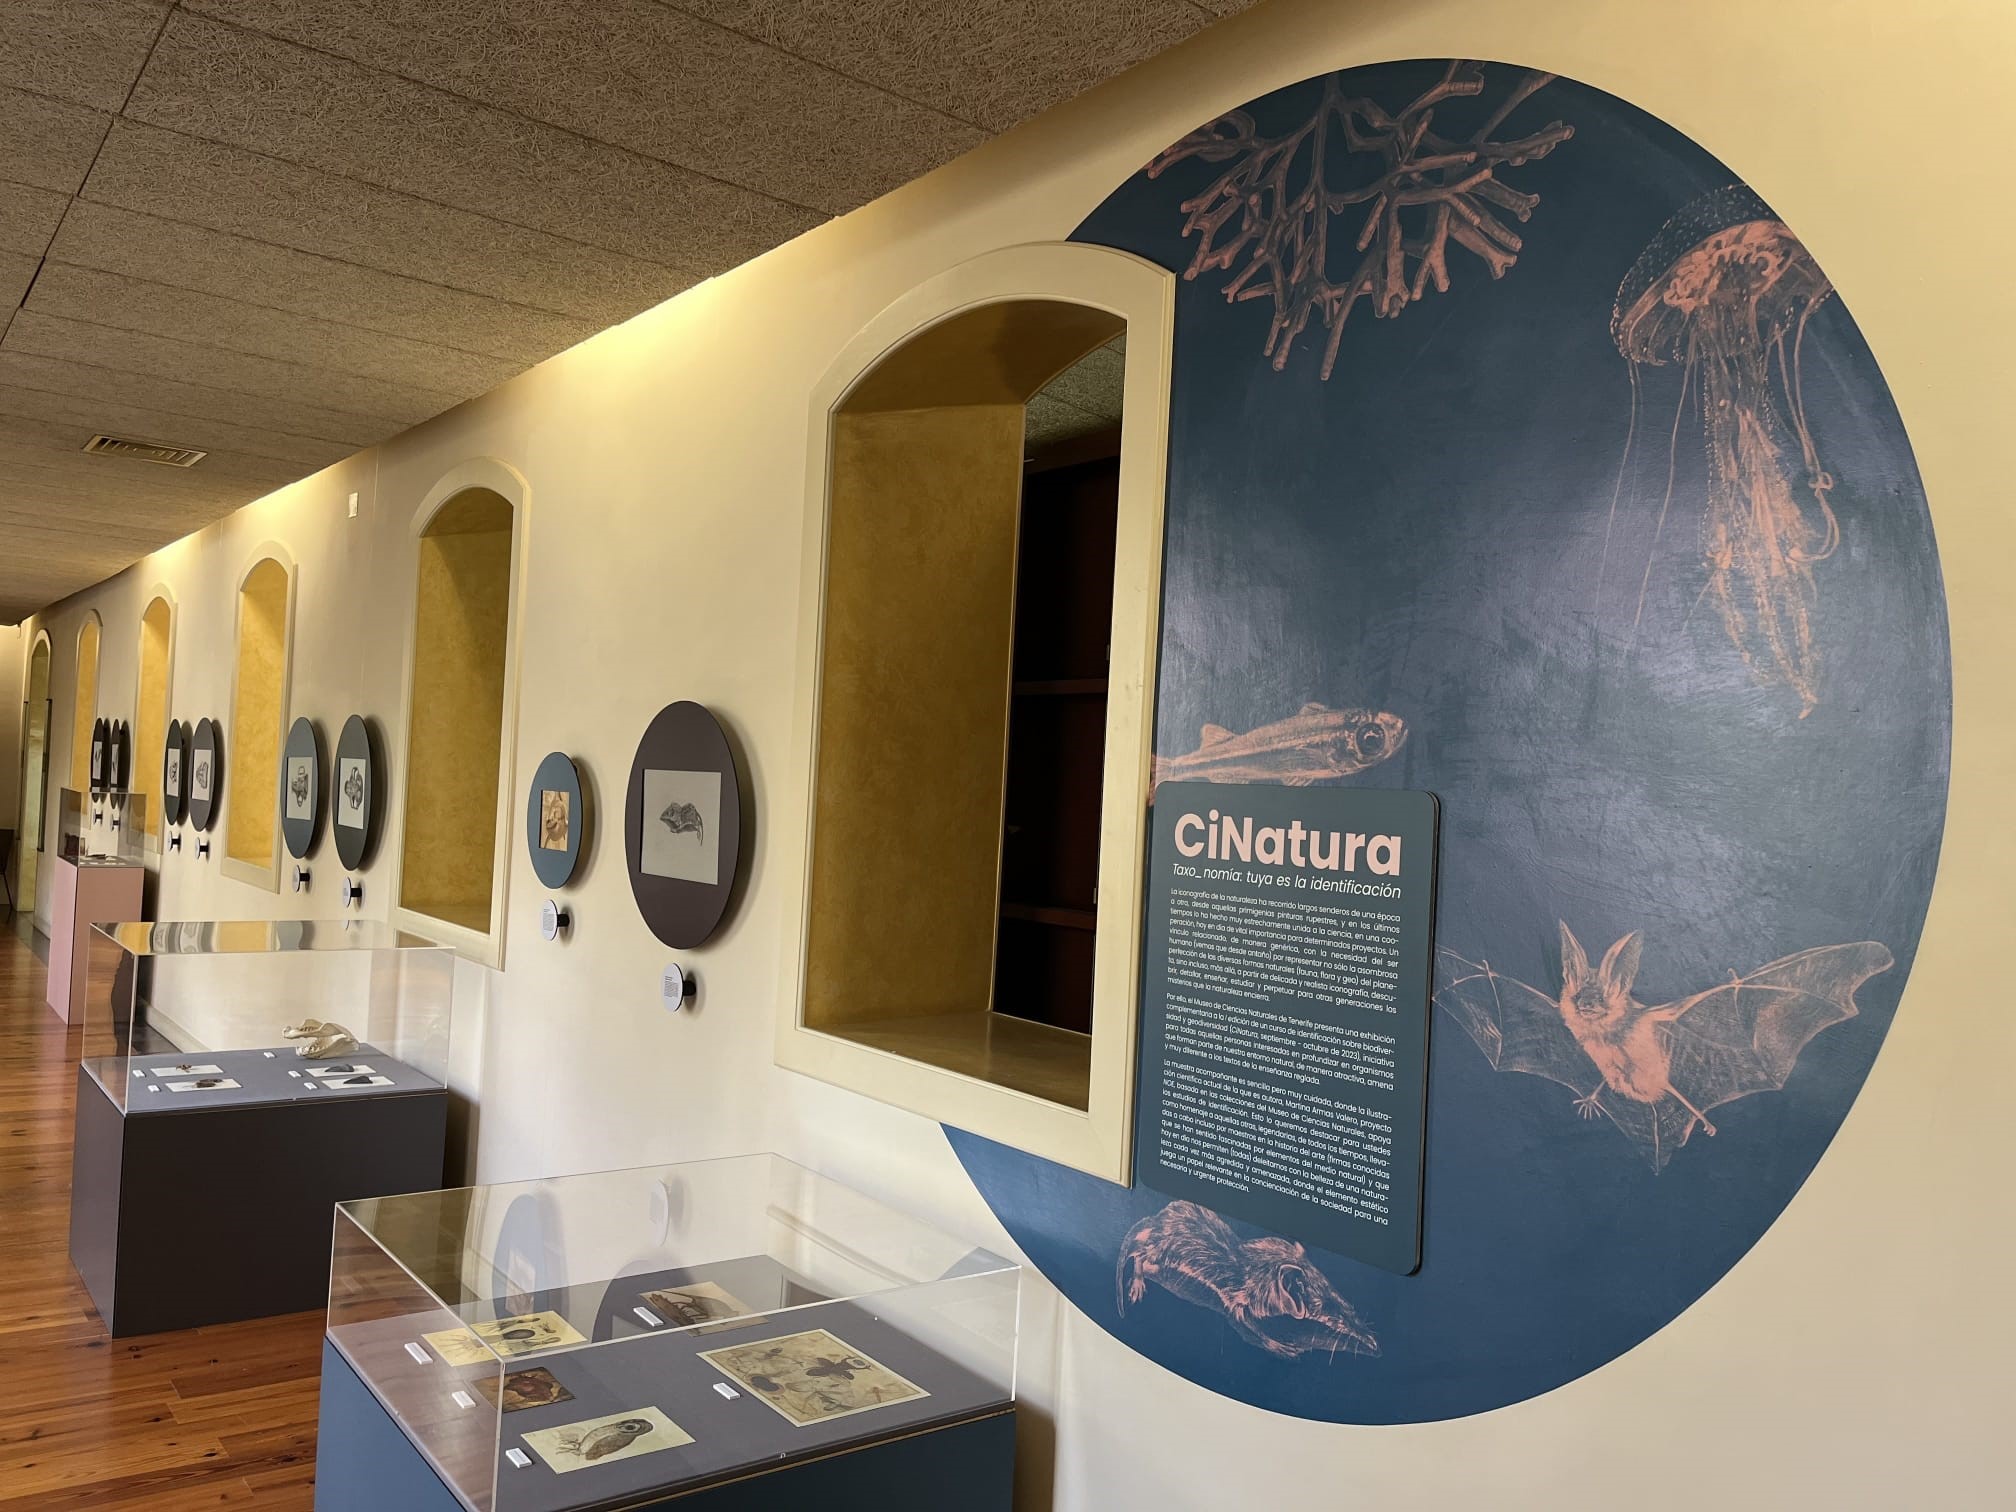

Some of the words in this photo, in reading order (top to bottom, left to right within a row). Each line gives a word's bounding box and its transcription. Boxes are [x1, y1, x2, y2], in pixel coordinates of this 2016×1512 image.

[1174, 809, 1401, 876] CiNatura
[1246, 872, 1273, 889] tuya
[1276, 875, 1290, 888] es
[1295, 873, 1306, 889] la
[1310, 876, 1401, 899] identificación
[1297, 902, 1318, 914] largos
[1319, 904, 1350, 916] senderos
[1277, 910, 1304, 923] pinturas
[1373, 922, 1400, 933] últimos
[1303, 935, 1351, 949] determinados
[1285, 954, 1322, 969] representar
[1357, 964, 1398, 979] asombrosa
[1330, 950, 1368, 963] necesidad
[1269, 972, 1298, 985] delicada
[1303, 978, 1328, 990] realista
[1335, 994, 1384, 1013] generaciones
[1288, 1015, 1313, 1028] Tenerife
[1314, 1020, 1344, 1036] presenta
[1359, 1029, 1396, 1044] exhibición
[1297, 1028, 1341, 1045] identificación
[1301, 1051, 1339, 1068] profundizar
[1351, 1061, 1394, 1080] organismos
[1303, 1040, 1329, 1053] octubre
[1362, 1052, 1395, 1067] iniciativa
[1306, 1064, 1333, 1076] manera
[1285, 1098, 1311, 1112] Martina
[1360, 1116, 1392, 1134] proyecto
[1301, 1113, 1330, 1128] Ciencias
[1274, 1118, 1308, 1135] queremos
[1310, 1126, 1340, 1142] destacar
[1362, 1140, 1391, 1155] ustedes
[1266, 1147, 1300, 1164] elementos
[1338, 1167, 1366, 1185] natural)
[1274, 1138, 1299, 1153] historia
[1327, 1153, 1351, 1169] (firmas
[1352, 1160, 1390, 1178] conocidas
[1310, 1170, 1334, 1185] belleza
[1320, 1196, 1353, 1213] sociedad
[1325, 1186, 1359, 1204] elemento
[1360, 1197, 1389, 1213] estético
